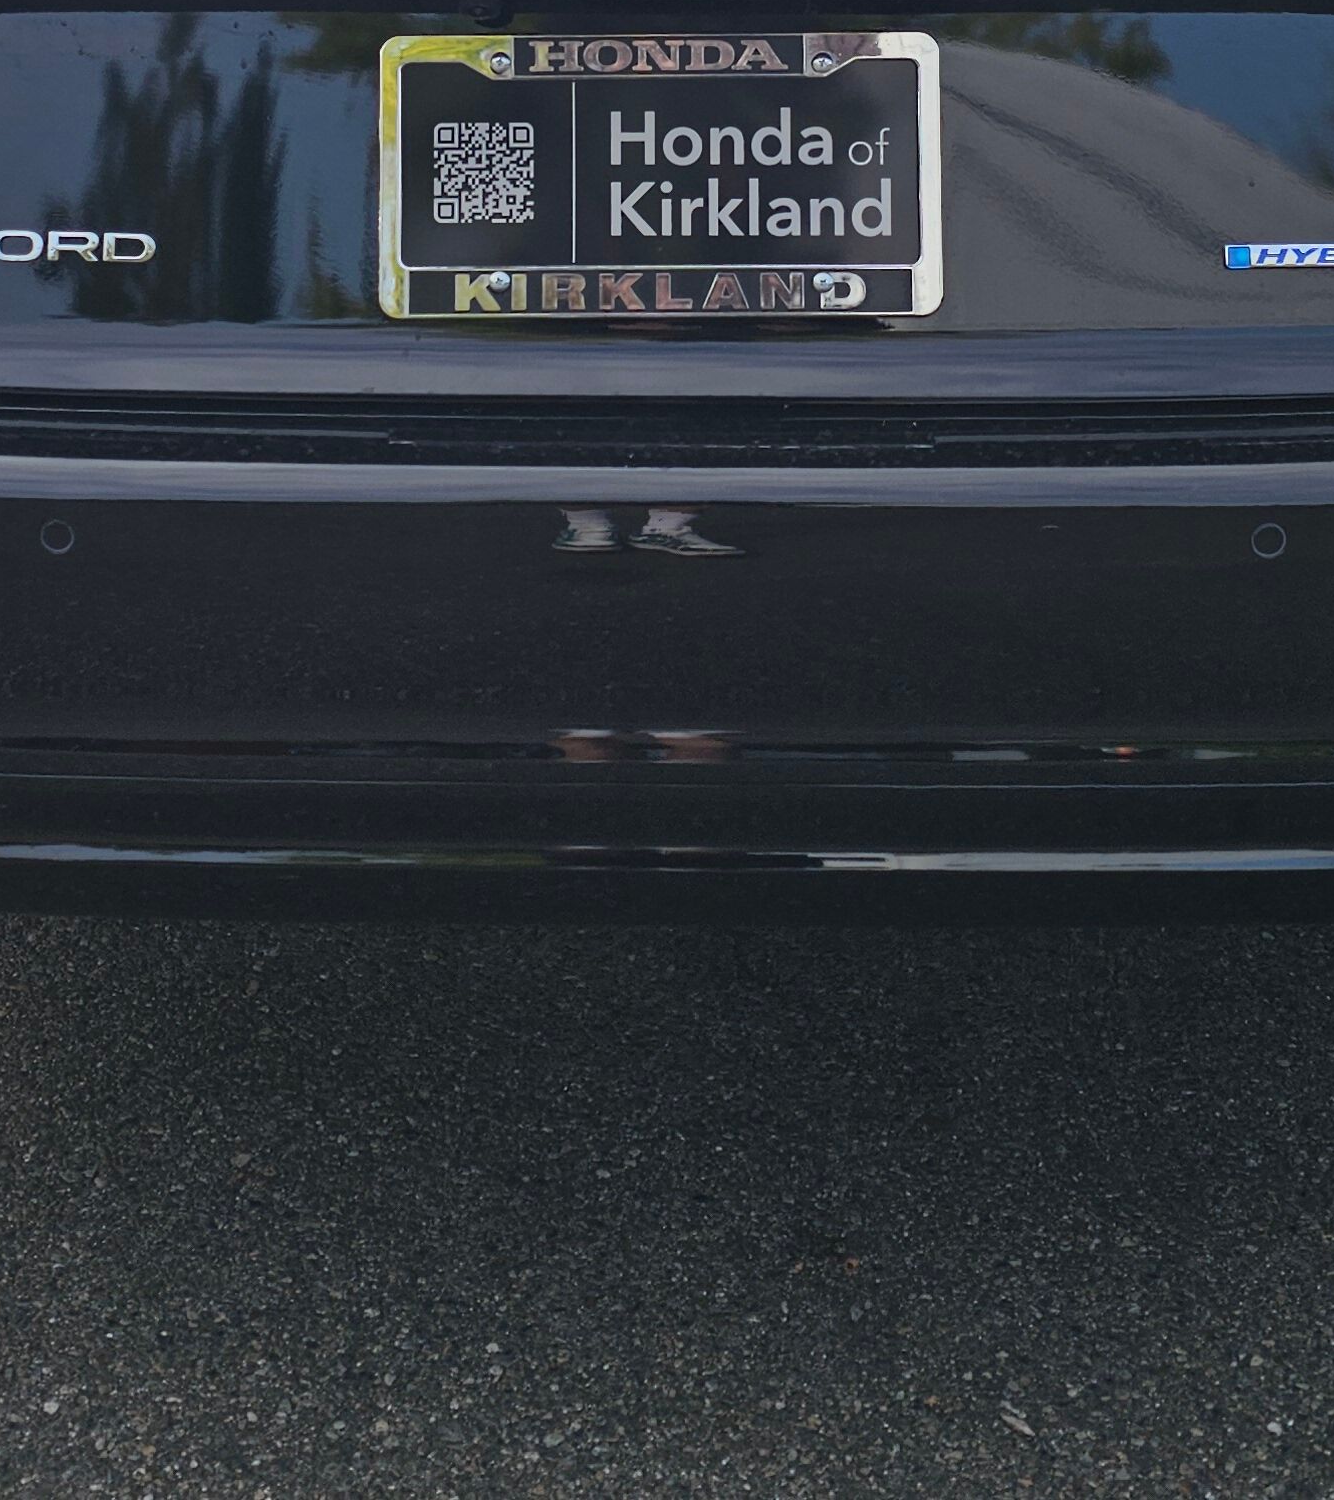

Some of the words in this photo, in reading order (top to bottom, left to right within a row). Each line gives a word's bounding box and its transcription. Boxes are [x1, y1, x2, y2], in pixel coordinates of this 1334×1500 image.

[528, 39, 789, 72] HONDA
[610, 107, 834, 166] Honda
[848, 127, 890, 166] of
[610, 178, 893, 237] Kirkland
[453, 271, 867, 312] KIRKLAND
